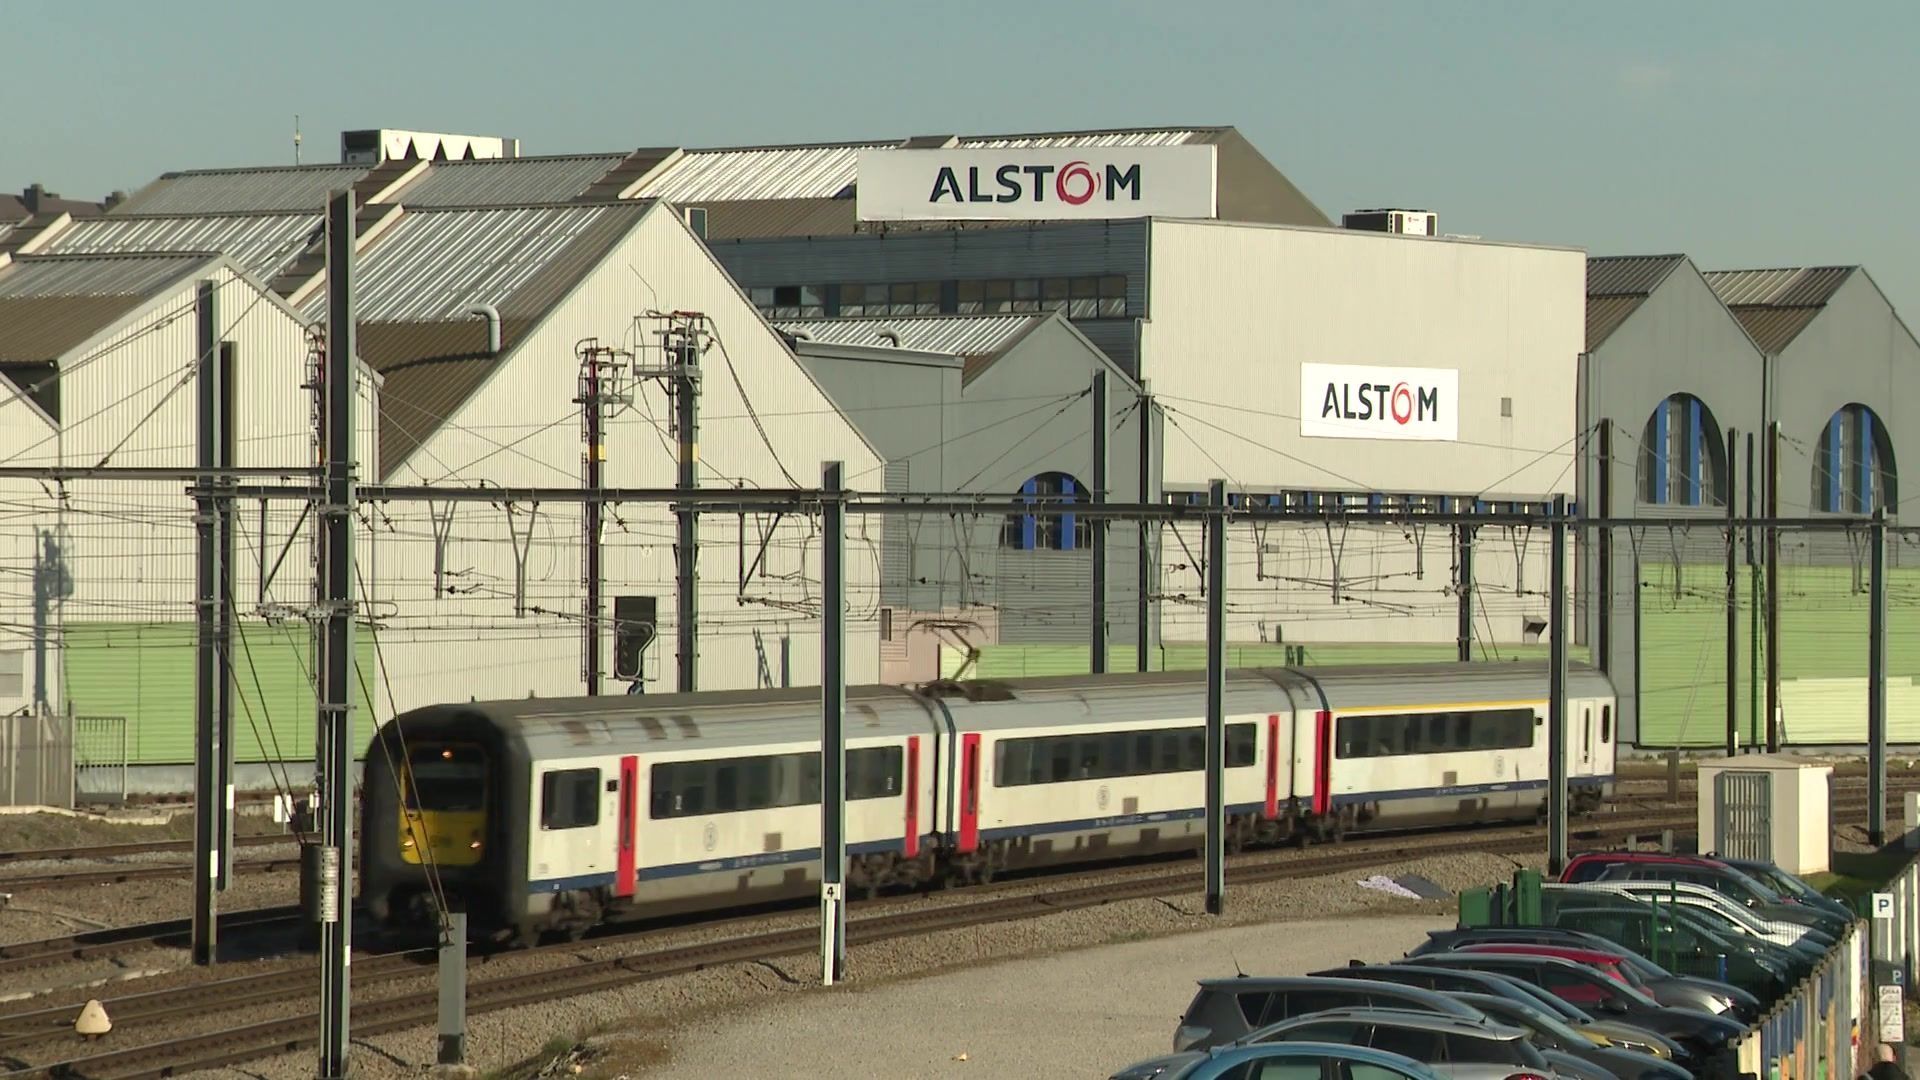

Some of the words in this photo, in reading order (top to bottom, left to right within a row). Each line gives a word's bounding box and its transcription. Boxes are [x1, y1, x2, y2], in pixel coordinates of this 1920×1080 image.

[929, 161, 1141, 205] ALSTOM
[1321, 381, 1438, 425] ALSTOM
[827, 886, 835, 898] 4
[1878, 899, 1889, 912] P
[1892, 970, 1903, 984] P
